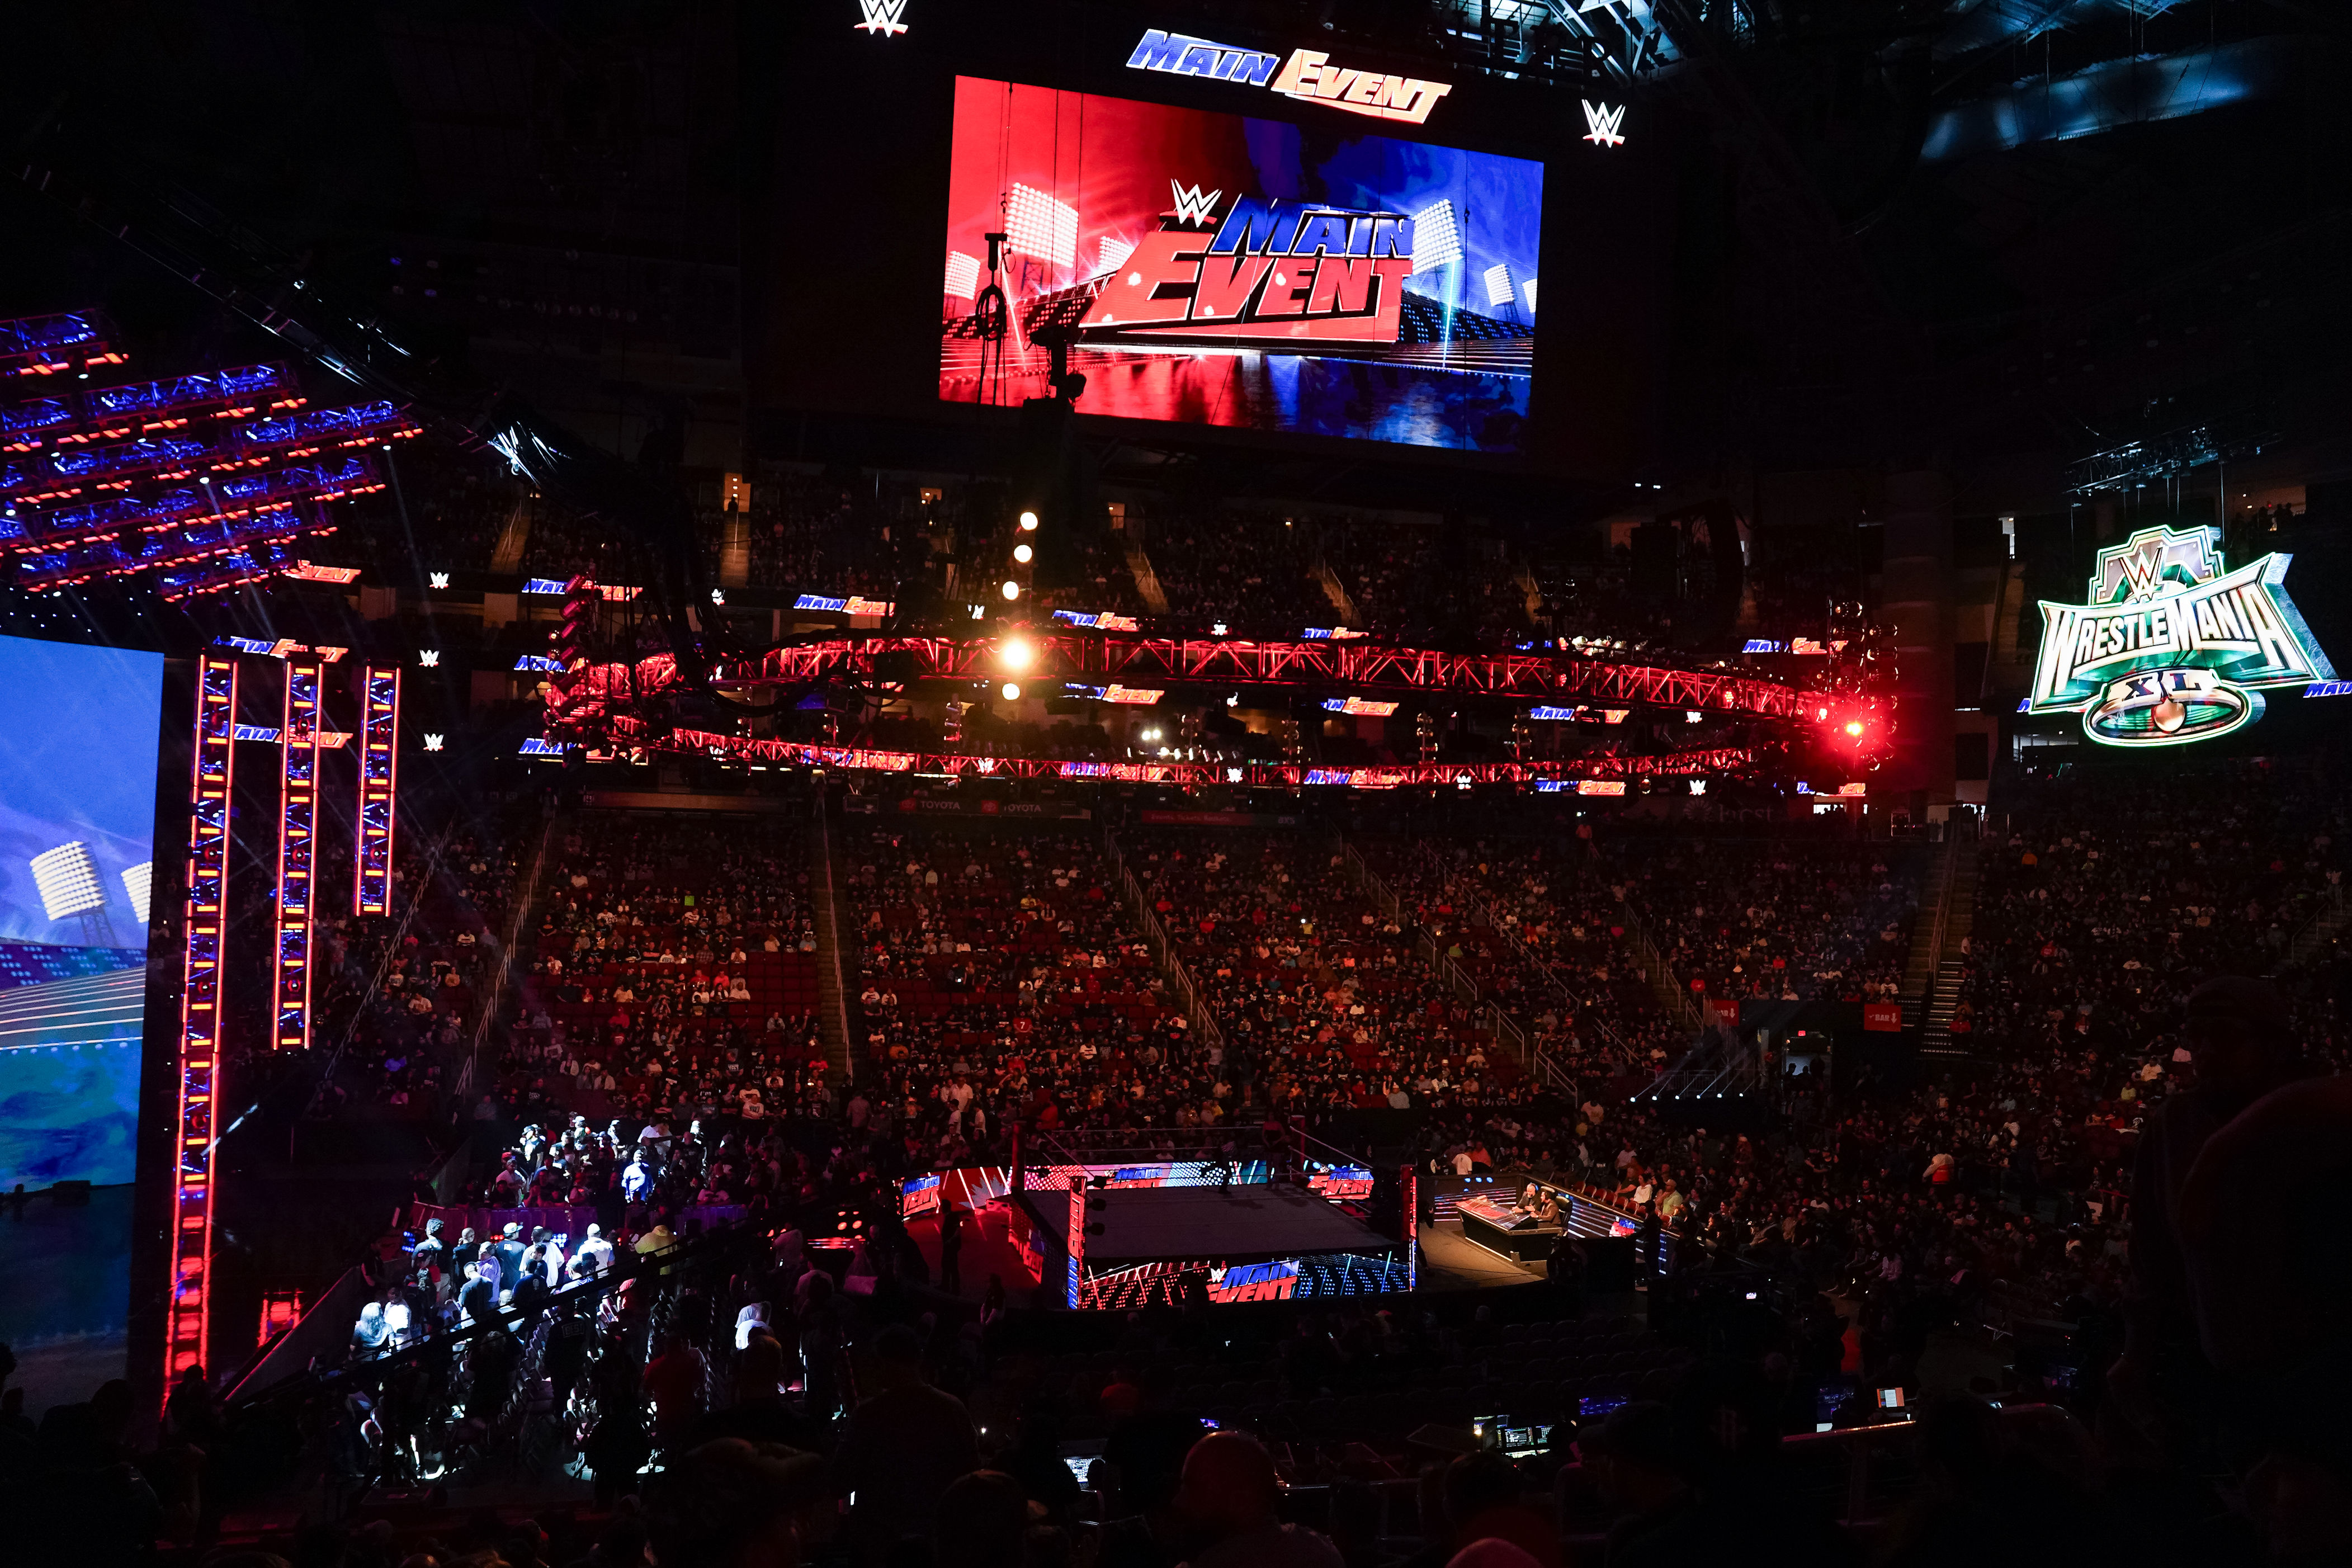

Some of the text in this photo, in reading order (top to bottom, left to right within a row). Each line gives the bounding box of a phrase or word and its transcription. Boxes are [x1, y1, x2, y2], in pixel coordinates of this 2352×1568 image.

[1126, 29, 1452, 124] MAIN EVENT
[1210, 193, 1415, 259] MAIN
[1078, 230, 1414, 342] EVENT
[794, 594, 847, 611] MAIN
[2035, 582, 2311, 706] WRESTLEMANIA
[1103, 684, 1165, 705] EVENT
[2126, 672, 2202, 700] XL
[1342, 697, 1399, 716] EVENT
[922, 801, 960, 810] TOYOTA
[1115, 1167, 1163, 1179] MAIN
[903, 1186, 939, 1216] VENT
[1220, 1260, 1300, 1290] MAIN
[1206, 1277, 1297, 1304] EVENT
